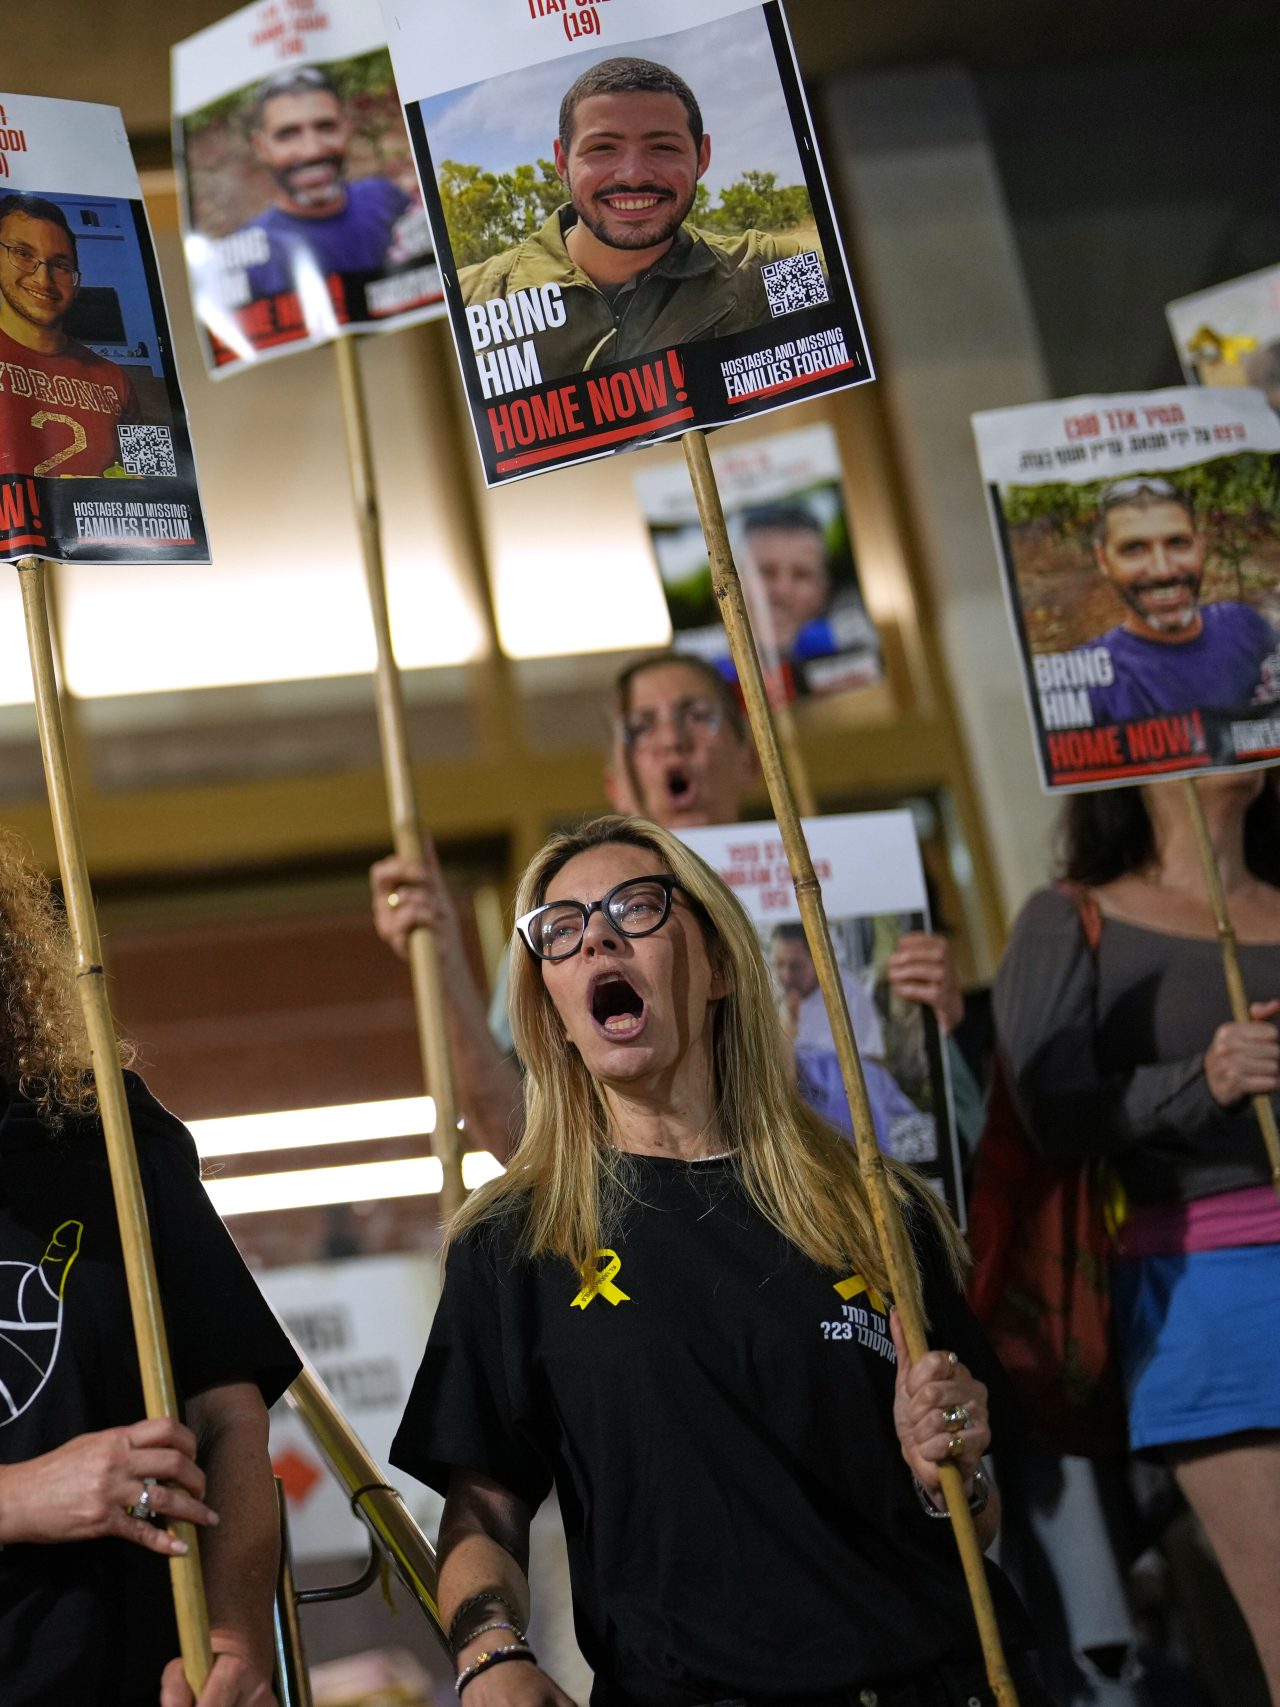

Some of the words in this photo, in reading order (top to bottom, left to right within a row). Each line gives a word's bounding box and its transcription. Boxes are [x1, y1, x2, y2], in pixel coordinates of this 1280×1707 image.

[563, 7, 601, 41] (19)
[465, 282, 568, 351] BRING
[475, 340, 543, 400] HIM
[720, 348, 774, 377] HOSTAGES
[775, 342, 796, 365] AND
[796, 327, 844, 354] MISSING
[724, 359, 793, 399] FAMILIES
[793, 342, 849, 378] FORUM
[486, 385, 584, 453] HOME
[584, 349, 688, 426] NOW!
[31, 410, 88, 479] 2
[73, 501, 123, 517] HOSTAGES
[125, 502, 144, 517] AND
[144, 503, 188, 518] MISSING
[75, 517, 140, 539] FAMILIES
[141, 518, 192, 539] FORUM
[1033, 646, 1115, 690] BRING
[1039, 689, 1094, 731] HIM
[1048, 726, 1125, 769] HOME
[1125, 708, 1207, 761] NOW!
[841, 1304, 868, 1327] מתי
[870, 1312, 886, 1335] עד
